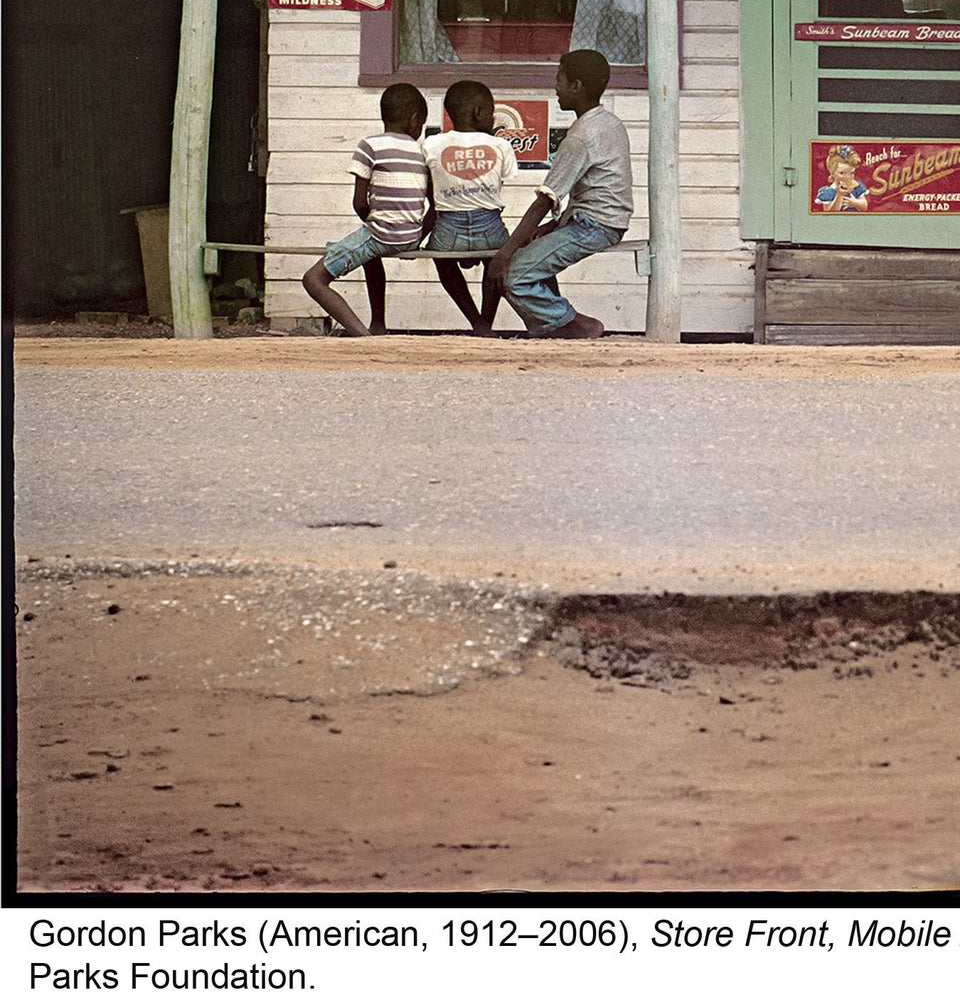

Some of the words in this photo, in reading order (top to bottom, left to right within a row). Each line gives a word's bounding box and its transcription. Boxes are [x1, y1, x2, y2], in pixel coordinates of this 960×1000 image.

[806, 26, 835, 35] Smith's
[841, 26, 909, 39] Sunbeam
[454, 149, 485, 160] RED
[865, 148, 888, 166] Reach
[446, 160, 494, 172] HEART
[919, 203, 949, 211] BREAD
